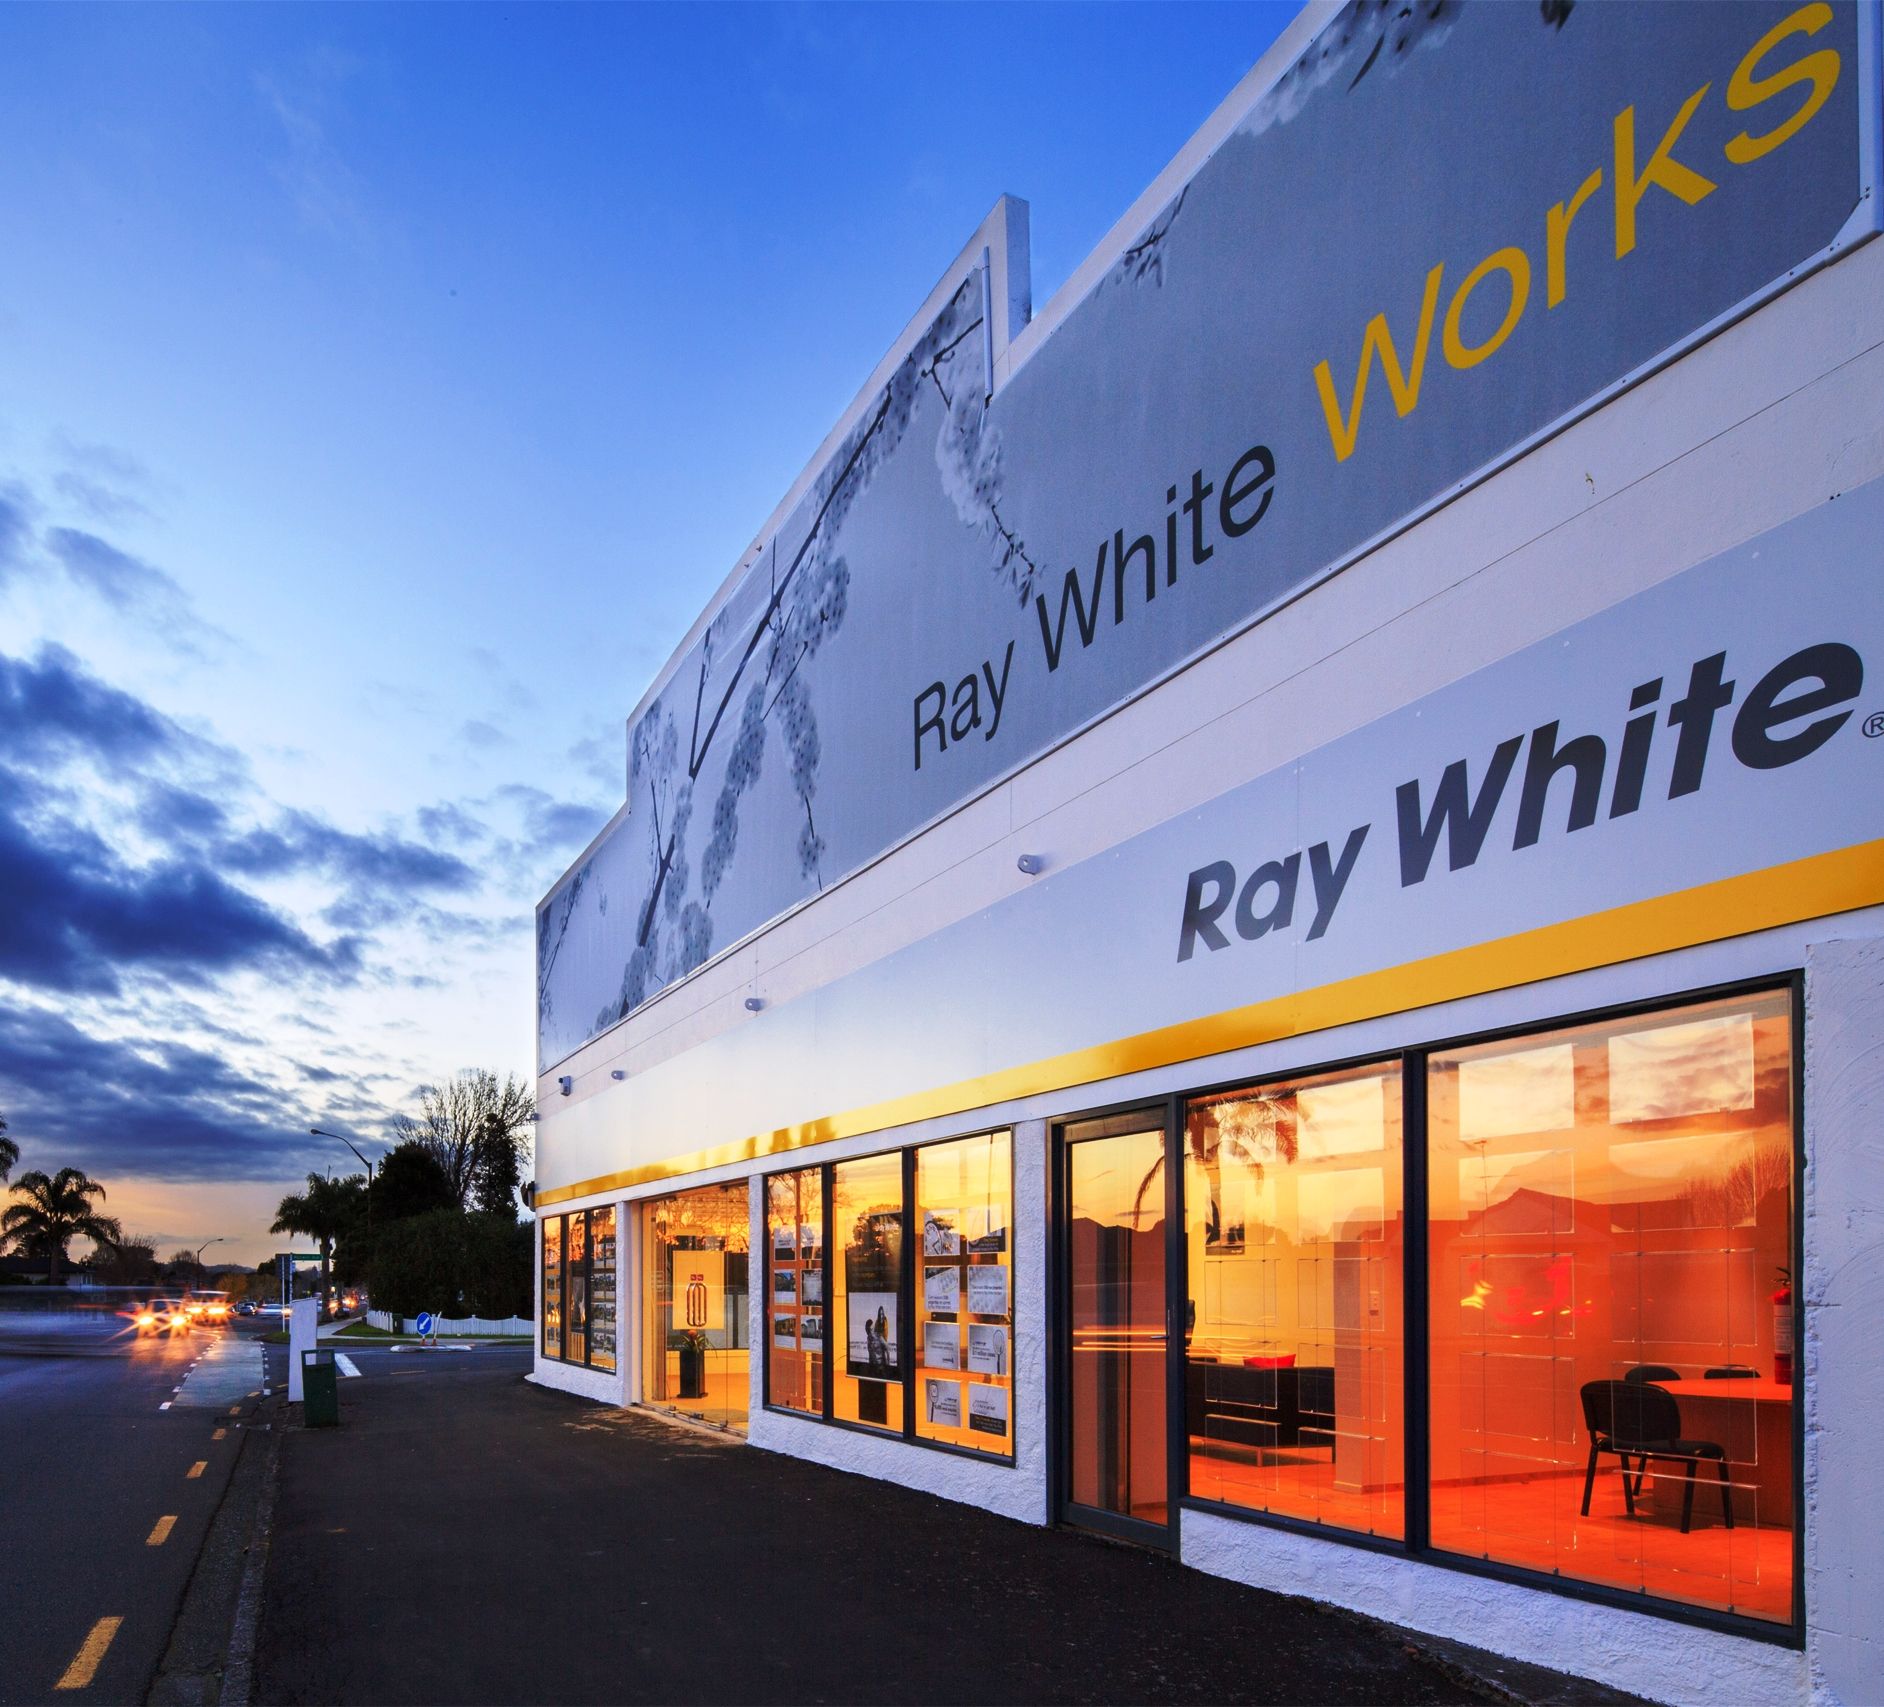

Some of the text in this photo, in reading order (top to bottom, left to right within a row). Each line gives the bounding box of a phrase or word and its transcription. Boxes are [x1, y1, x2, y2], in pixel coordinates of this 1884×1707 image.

[914, 2, 1841, 771] Ray White Works
[1177, 823, 1371, 963] Ray
[1395, 642, 1864, 888] White
